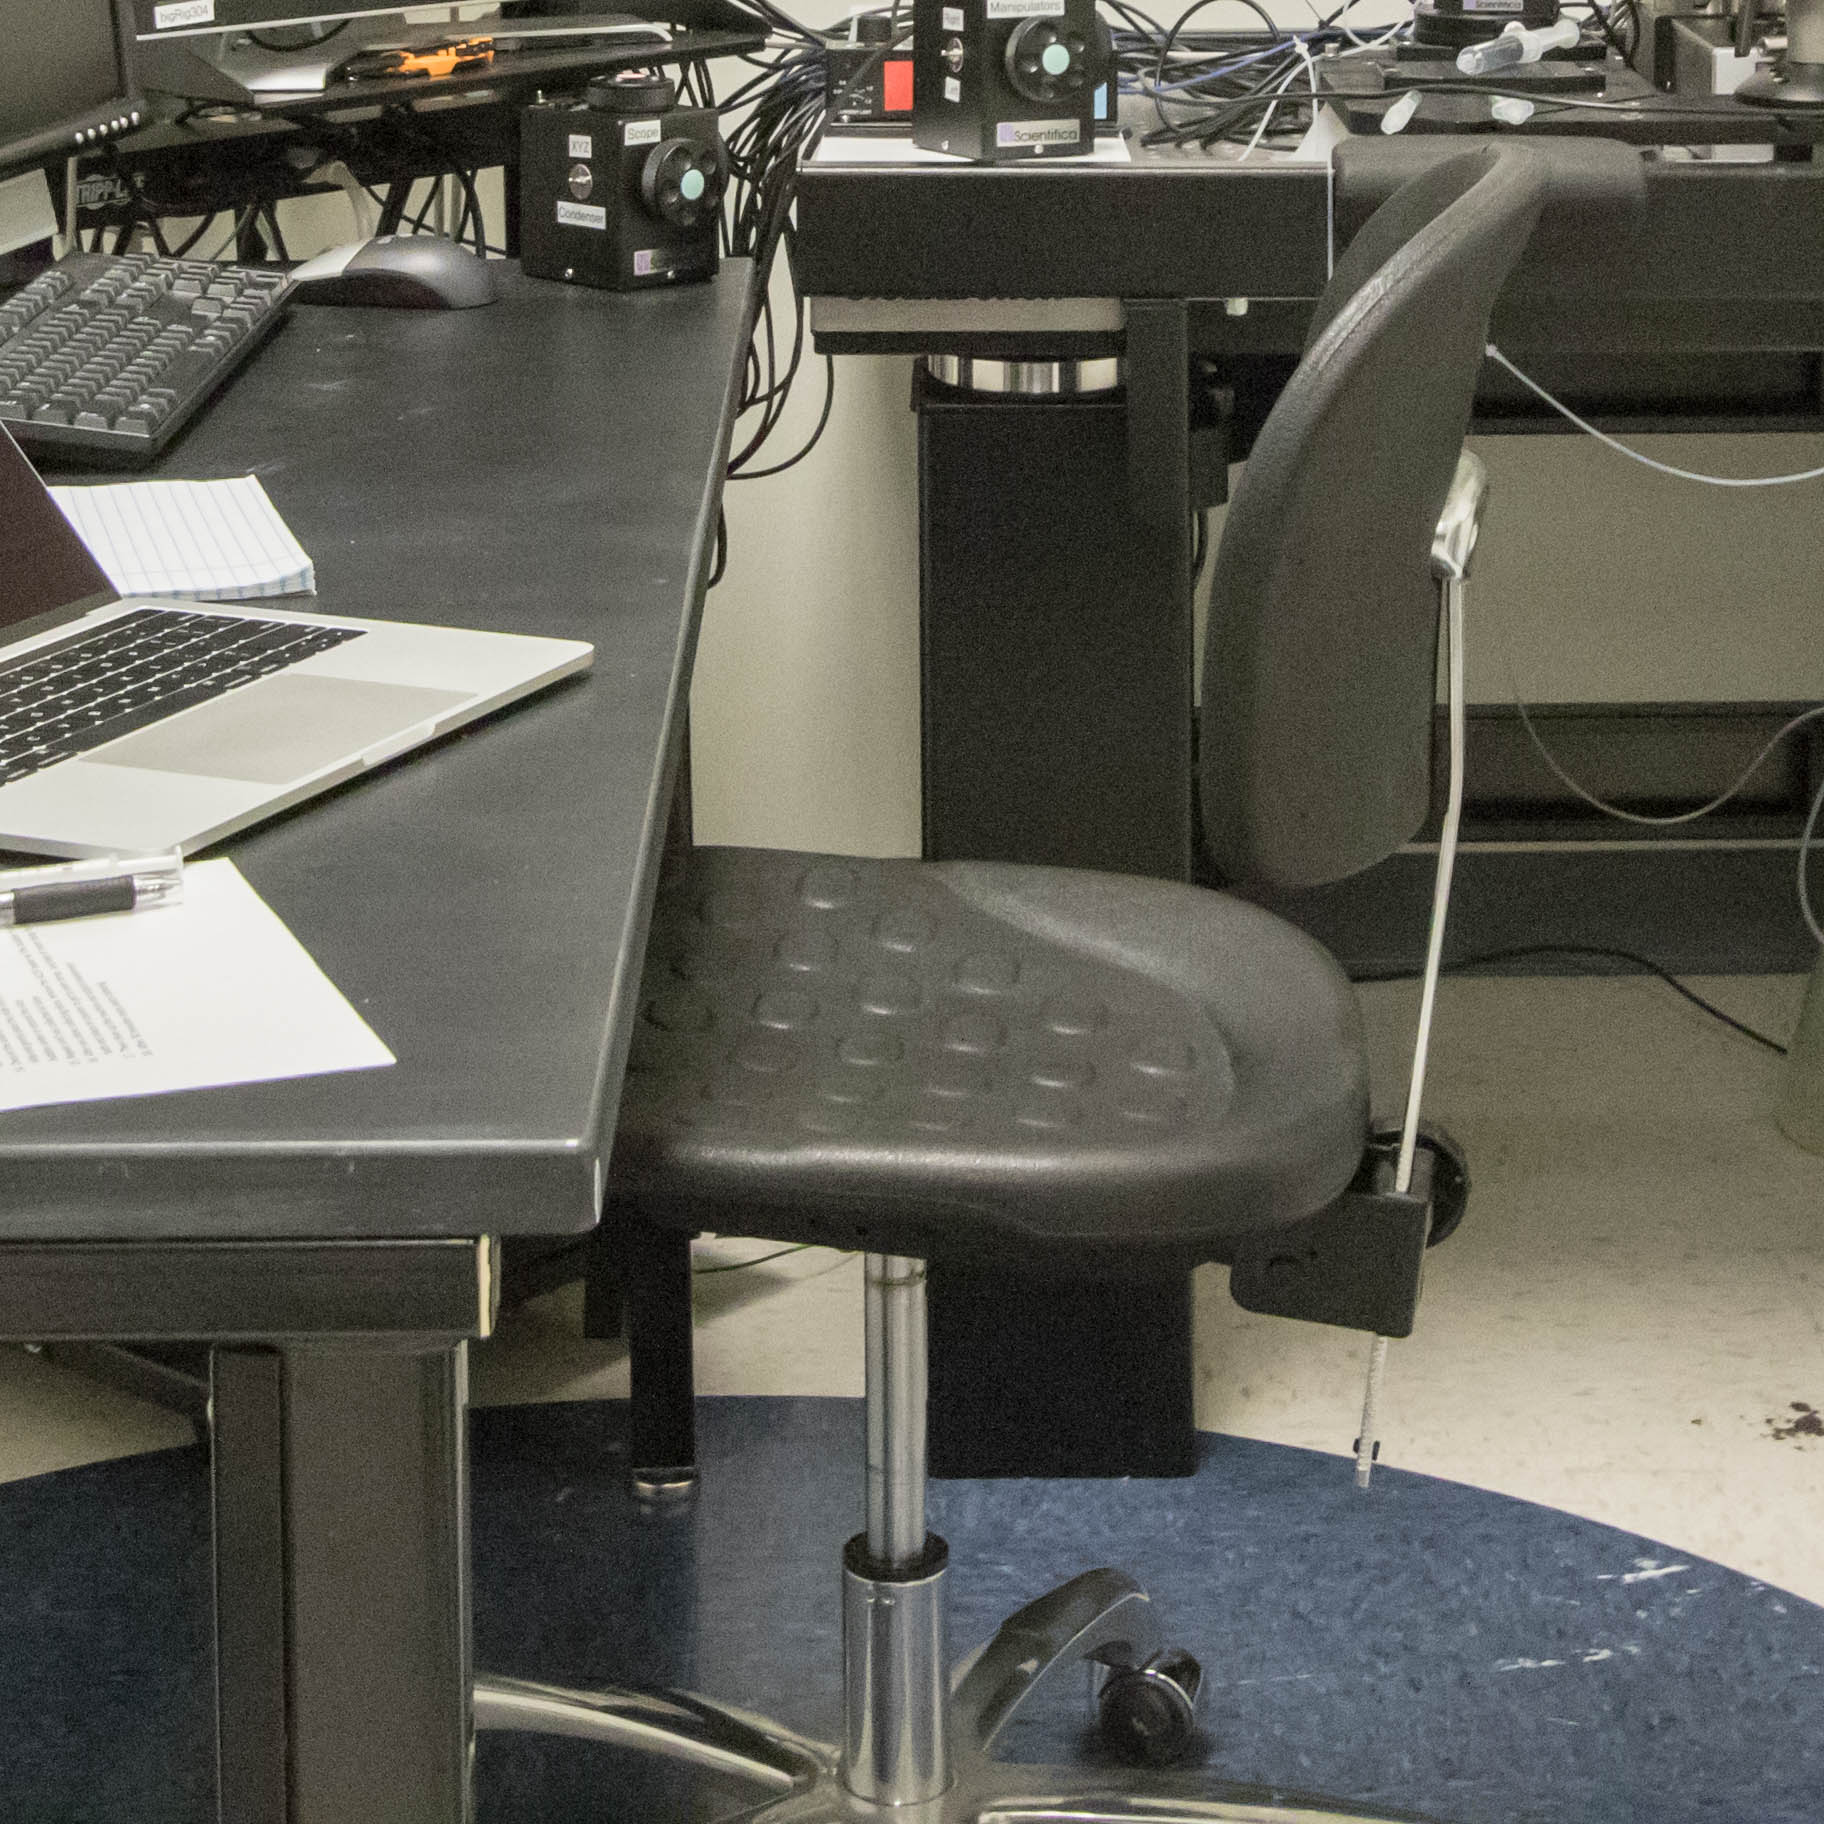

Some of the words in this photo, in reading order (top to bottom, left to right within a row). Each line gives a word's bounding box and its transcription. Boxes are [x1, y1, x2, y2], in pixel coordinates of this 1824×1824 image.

[990, 0, 1062, 14] Manipulators
[627, 128, 659, 141] Scope
[1014, 128, 1078, 143] Scientifica
[571, 140, 590, 154] XYZ
[559, 206, 604, 224] Condenser
